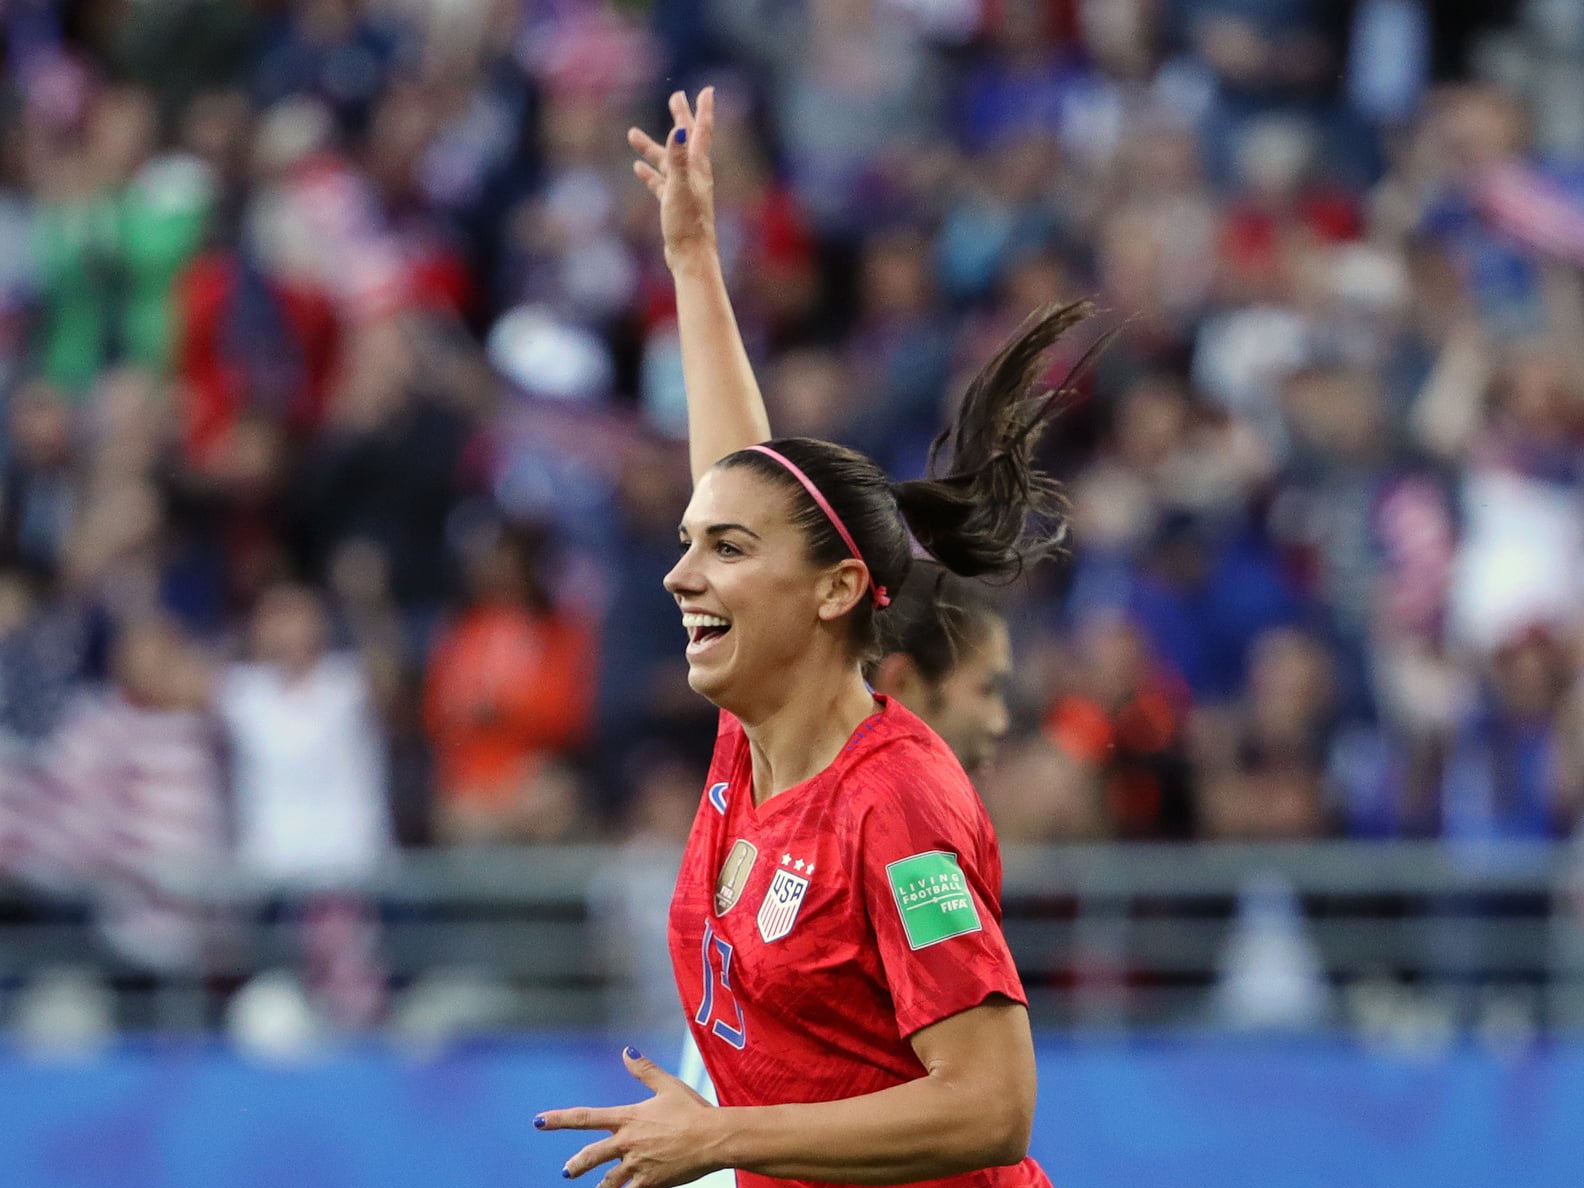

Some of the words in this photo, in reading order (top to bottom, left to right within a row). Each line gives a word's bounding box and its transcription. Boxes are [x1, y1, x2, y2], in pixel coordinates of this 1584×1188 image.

[773, 874, 804, 903] USA
[899, 874, 960, 895] LIVING
[902, 882, 962, 904] FOOTBALL
[940, 898, 968, 913] FIFA
